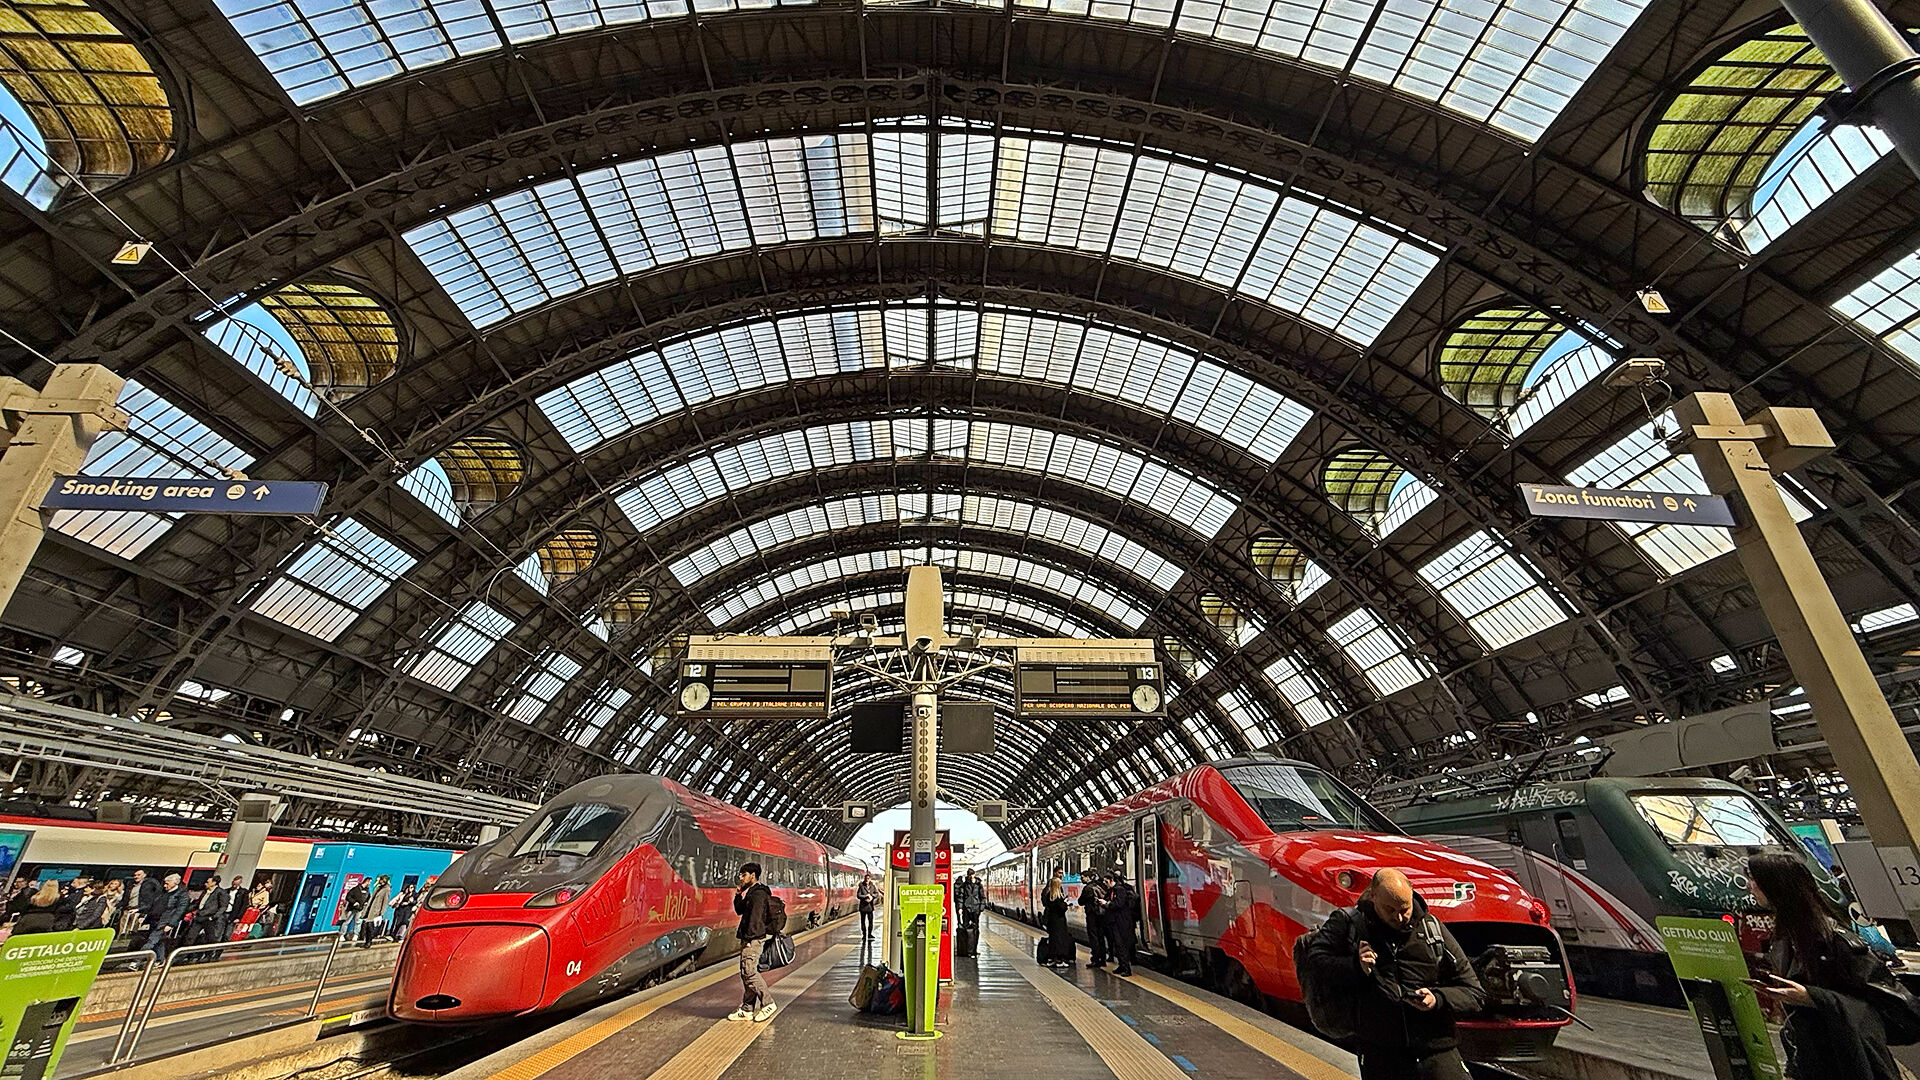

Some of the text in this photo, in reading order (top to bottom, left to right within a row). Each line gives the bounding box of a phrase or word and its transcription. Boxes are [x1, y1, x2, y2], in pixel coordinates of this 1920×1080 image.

[60, 479, 215, 501] Smoking area
[1531, 488, 1656, 509] Zona fumatori
[689, 665, 702, 678] 12
[1140, 667, 1154, 680] 13
[1892, 866, 1920, 886] 13
[1662, 926, 1735, 943] GETTALO QUI!
[5, 939, 107, 960] GETTALO QUI!
[566, 960, 582, 977] 04
